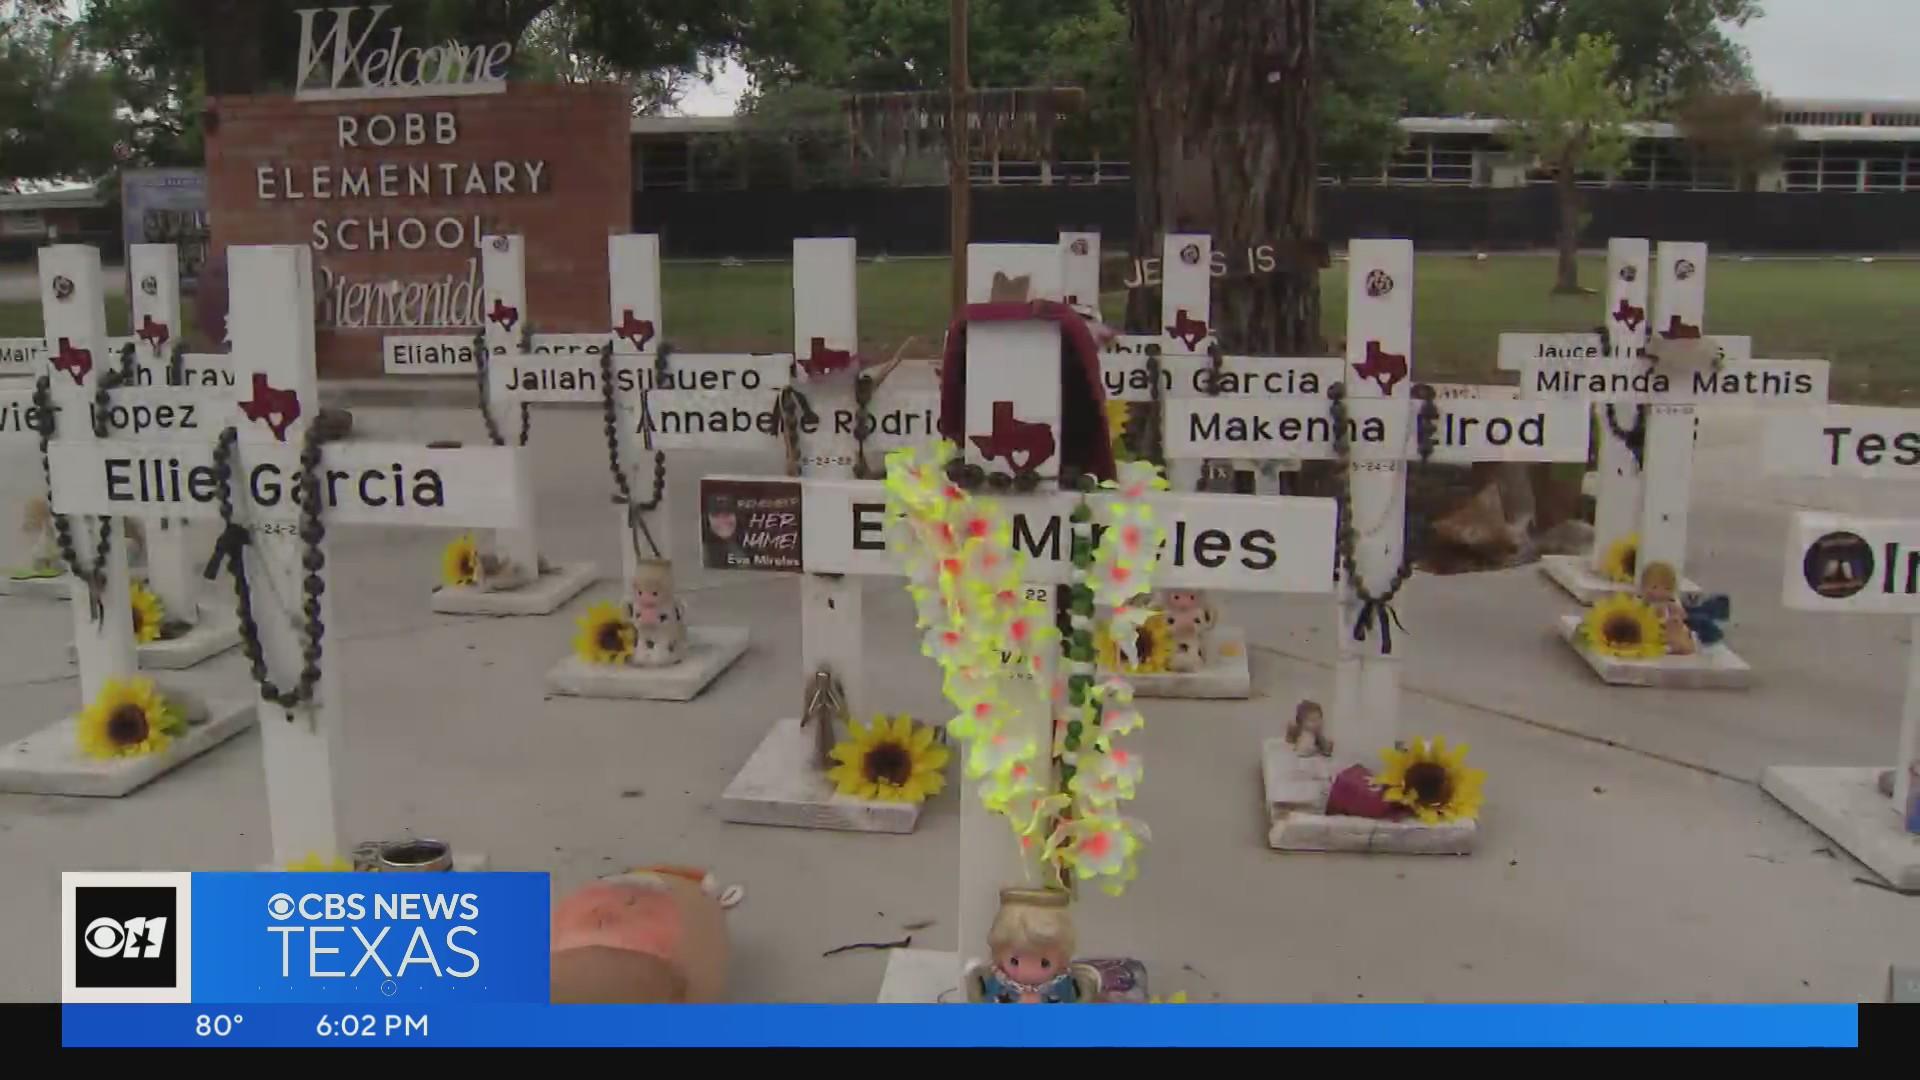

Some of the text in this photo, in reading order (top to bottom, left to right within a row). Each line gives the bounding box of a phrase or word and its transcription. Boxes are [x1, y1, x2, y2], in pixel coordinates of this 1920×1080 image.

[294, 5, 513, 87] Welcome
[338, 111, 459, 149] ROBB
[256, 160, 547, 200] ELEMENTARY
[312, 215, 487, 252] SCHOOL
[1123, 244, 1277, 289] JES IS
[505, 367, 596, 391] Jailah
[1536, 368, 1813, 396] Miranda Mathis
[833, 407, 941, 435] Rodri
[104, 457, 217, 503] Ellie
[748, 512, 799, 529] HER
